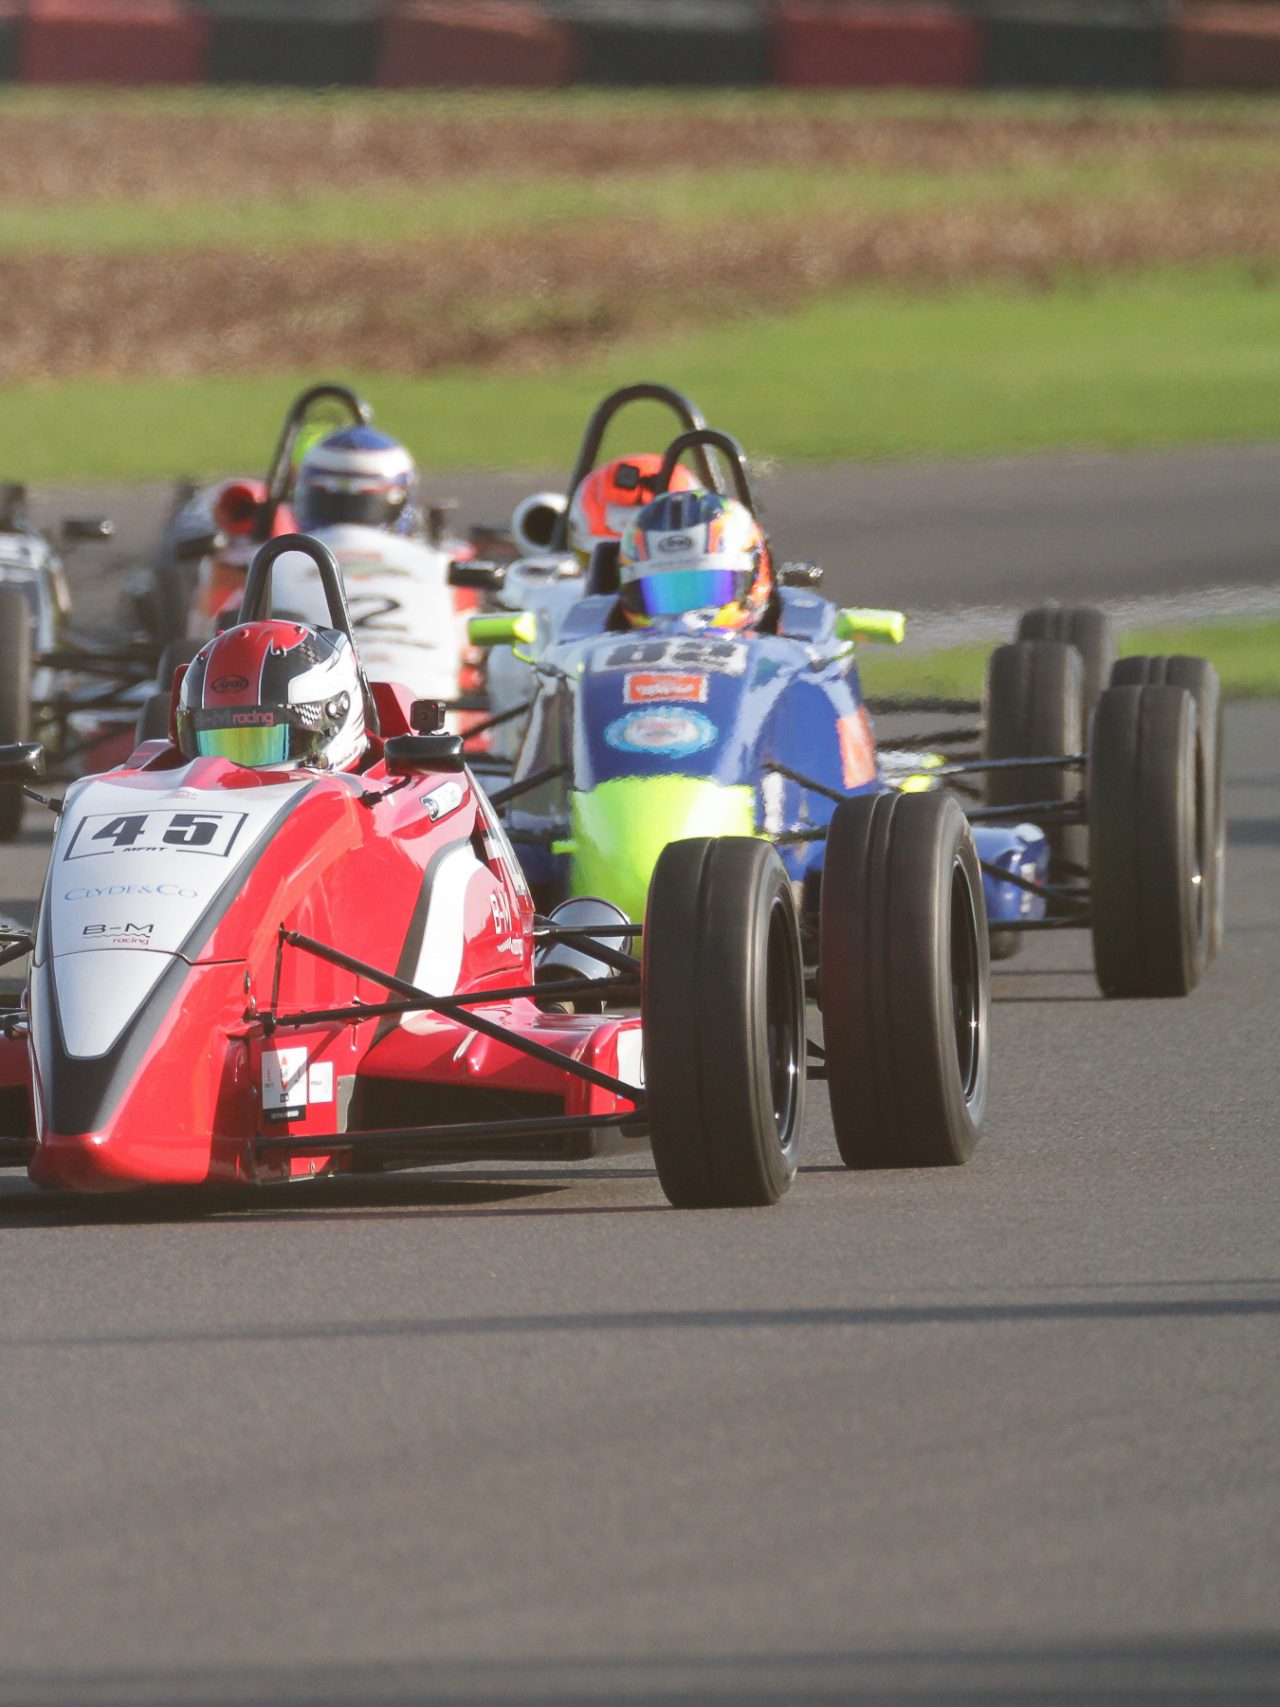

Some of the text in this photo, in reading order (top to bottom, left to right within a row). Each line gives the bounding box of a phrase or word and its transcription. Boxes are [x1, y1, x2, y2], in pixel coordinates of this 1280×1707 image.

[232, 709, 274, 727] racing
[91, 814, 223, 847] 45
[82, 923, 154, 935] B-M
[113, 937, 149, 945] racing
